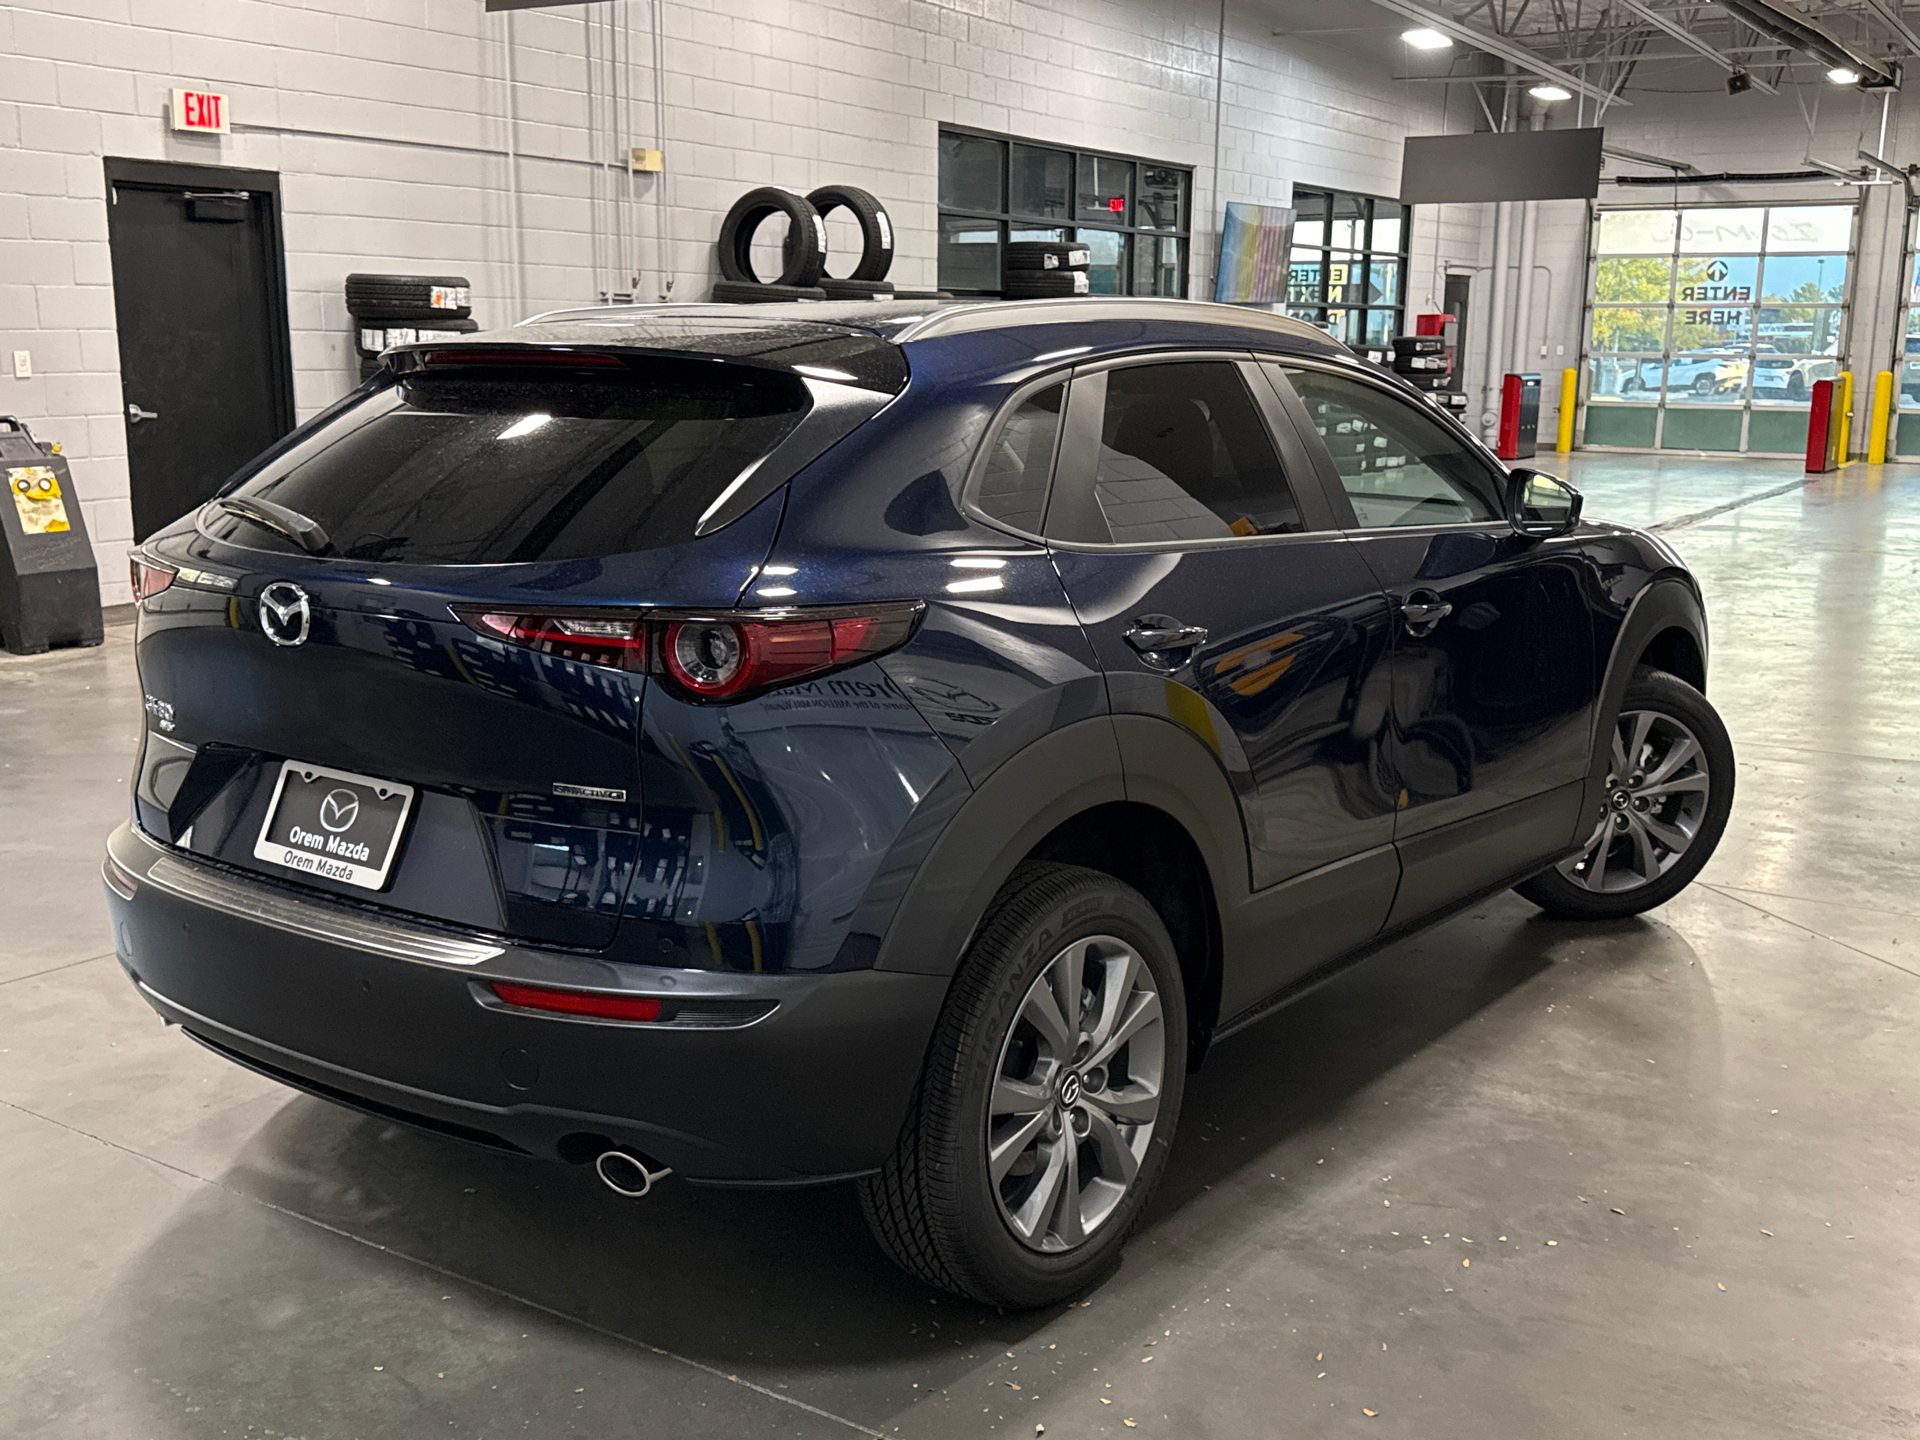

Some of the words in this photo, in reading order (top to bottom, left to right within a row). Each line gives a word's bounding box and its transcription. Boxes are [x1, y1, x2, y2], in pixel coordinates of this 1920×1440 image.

[184, 92, 221, 129] EXIT
[289, 826, 324, 850] Orem
[326, 835, 370, 862] Mazda
[283, 850, 314, 870] Orem
[315, 858, 354, 881] Mazda
